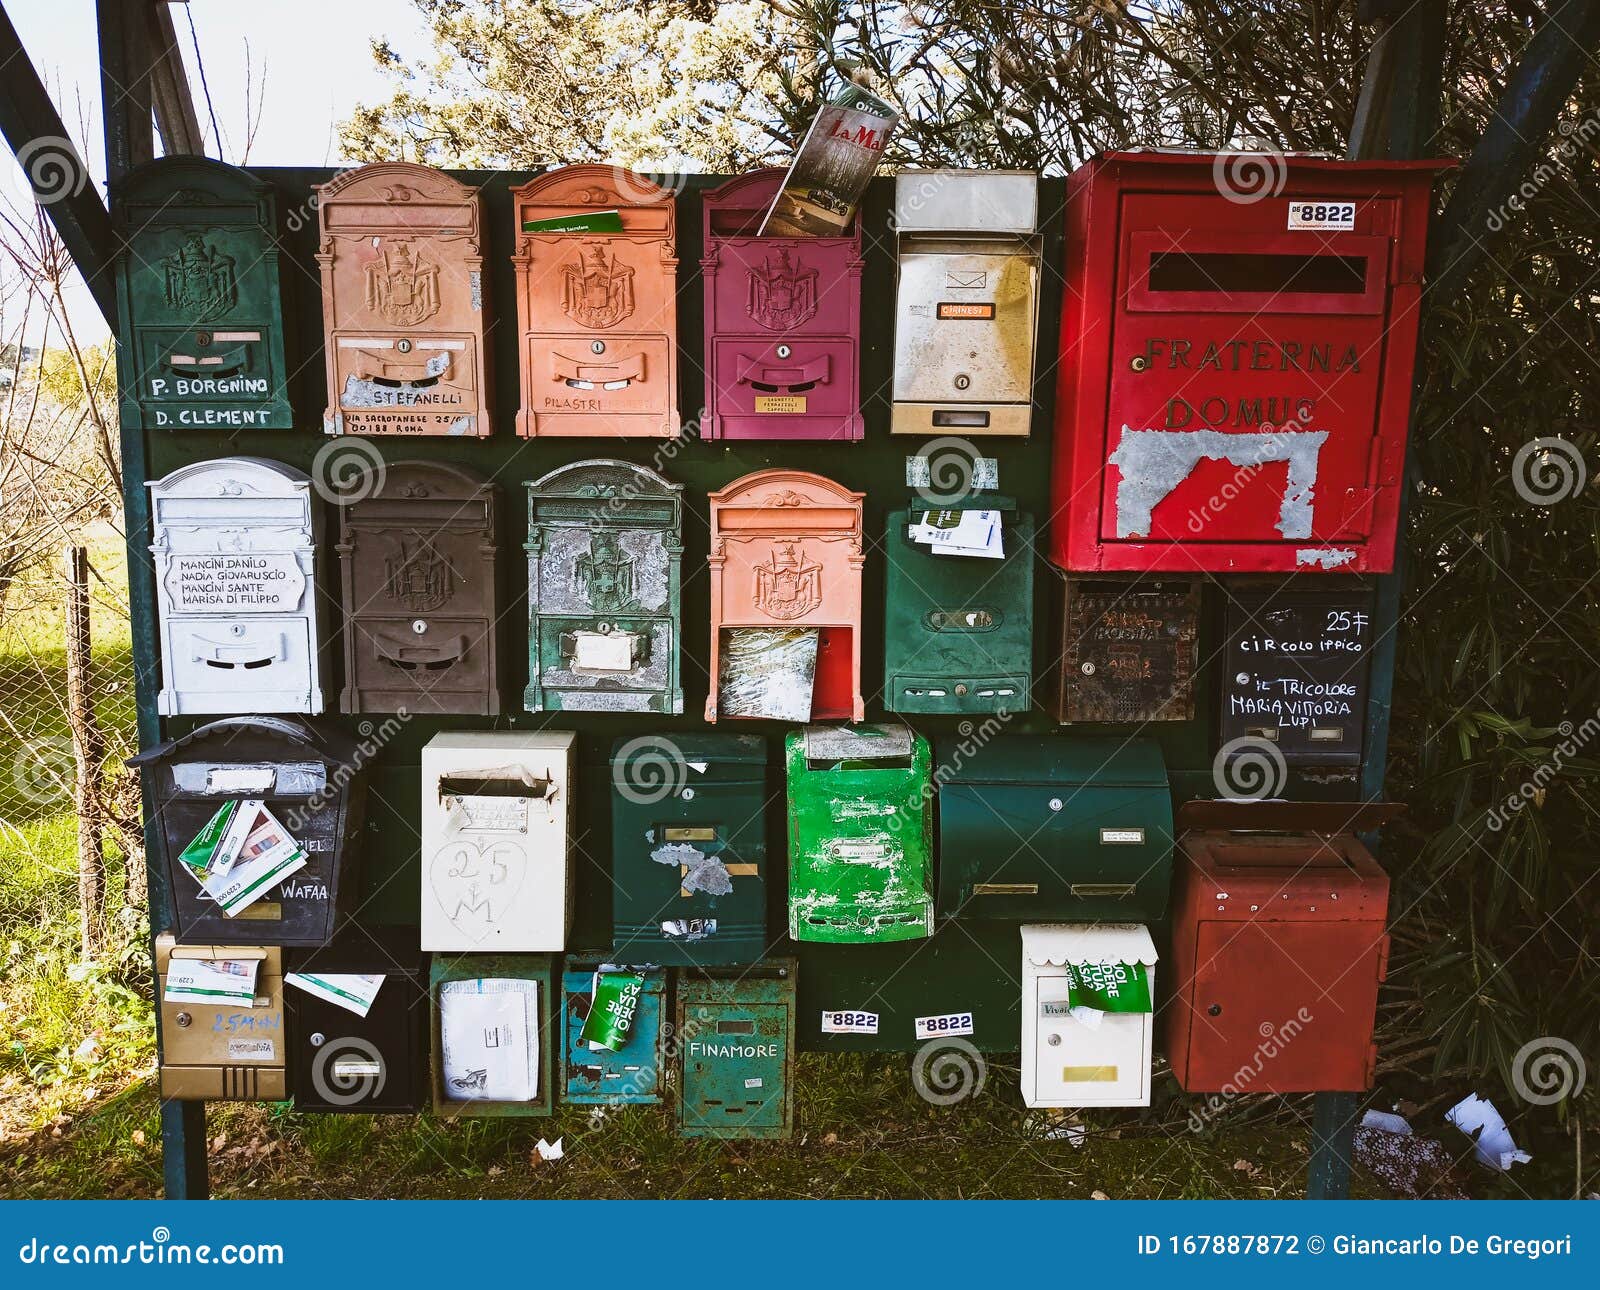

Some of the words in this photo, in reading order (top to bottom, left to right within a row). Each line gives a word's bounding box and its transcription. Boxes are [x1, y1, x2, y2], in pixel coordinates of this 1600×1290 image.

[1301, 206, 1353, 221] 8822
[1145, 339, 1360, 373] FRATERNA
[152, 379, 169, 395] P.
[545, 397, 601, 410] PILASTRI
[156, 411, 173, 425] D.
[180, 410, 271, 425] CLEMENT
[1166, 397, 1314, 428] DOMUS
[228, 584, 264, 593] SANTE
[280, 880, 327, 900] WAFAA
[452, 898, 493, 923] M
[613, 1017, 631, 1031] OI
[833, 1013, 877, 1027] 8822
[927, 1015, 972, 1031] 8822
[690, 1043, 777, 1058] FINAMORE
